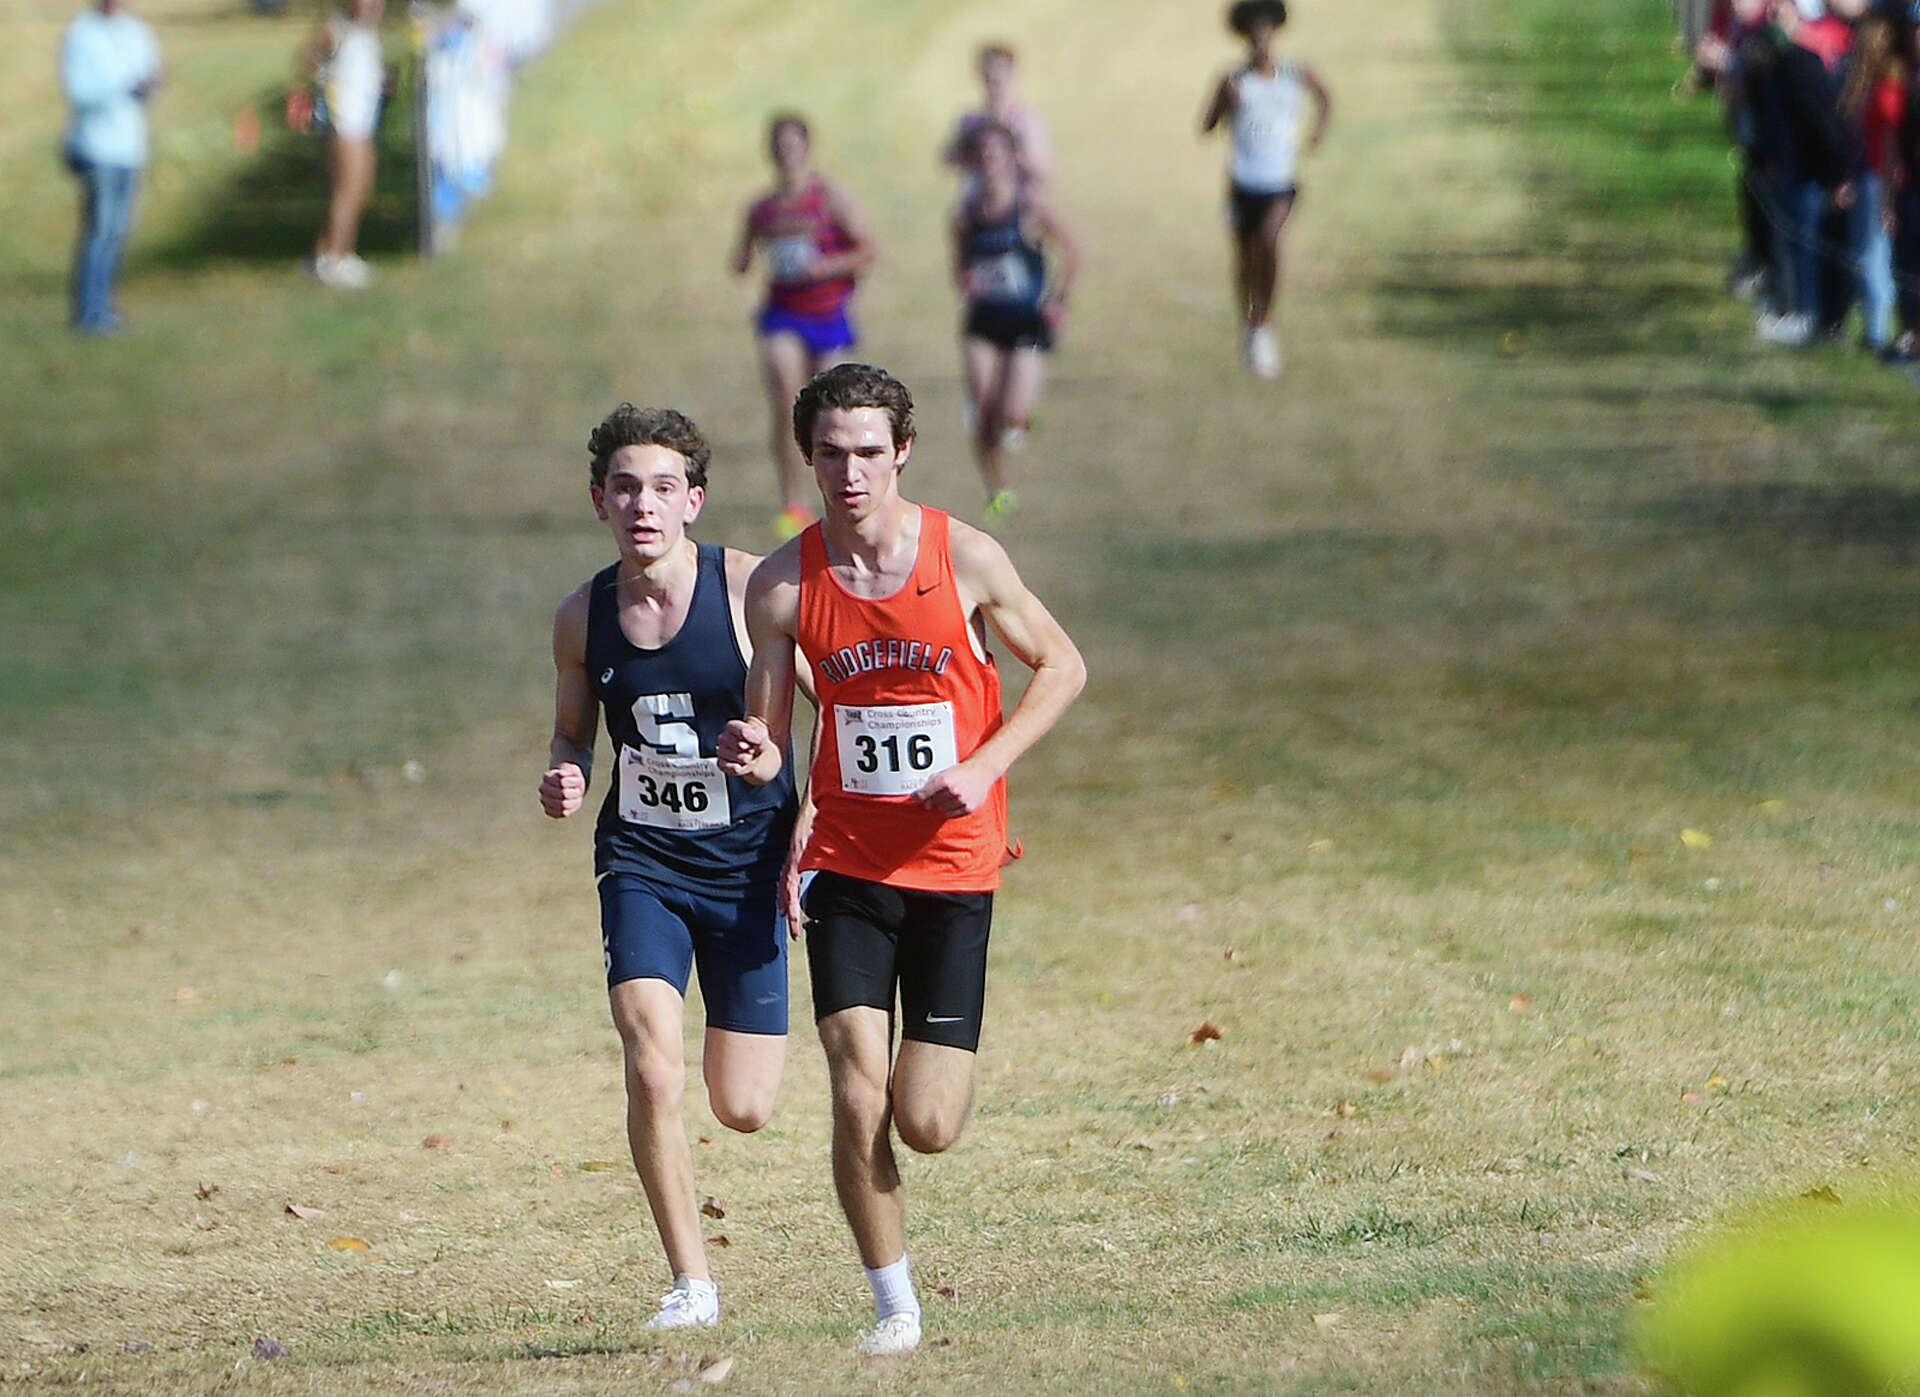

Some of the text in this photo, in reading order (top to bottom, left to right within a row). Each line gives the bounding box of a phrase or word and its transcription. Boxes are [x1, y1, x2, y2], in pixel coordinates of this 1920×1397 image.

[818, 639, 953, 684] RIDGEFIELD
[631, 692, 699, 758] S
[866, 709, 893, 718] Cross
[896, 708, 937, 719] Country
[867, 719, 942, 730] Championships
[855, 734, 934, 773] 316
[638, 774, 709, 813] 346
